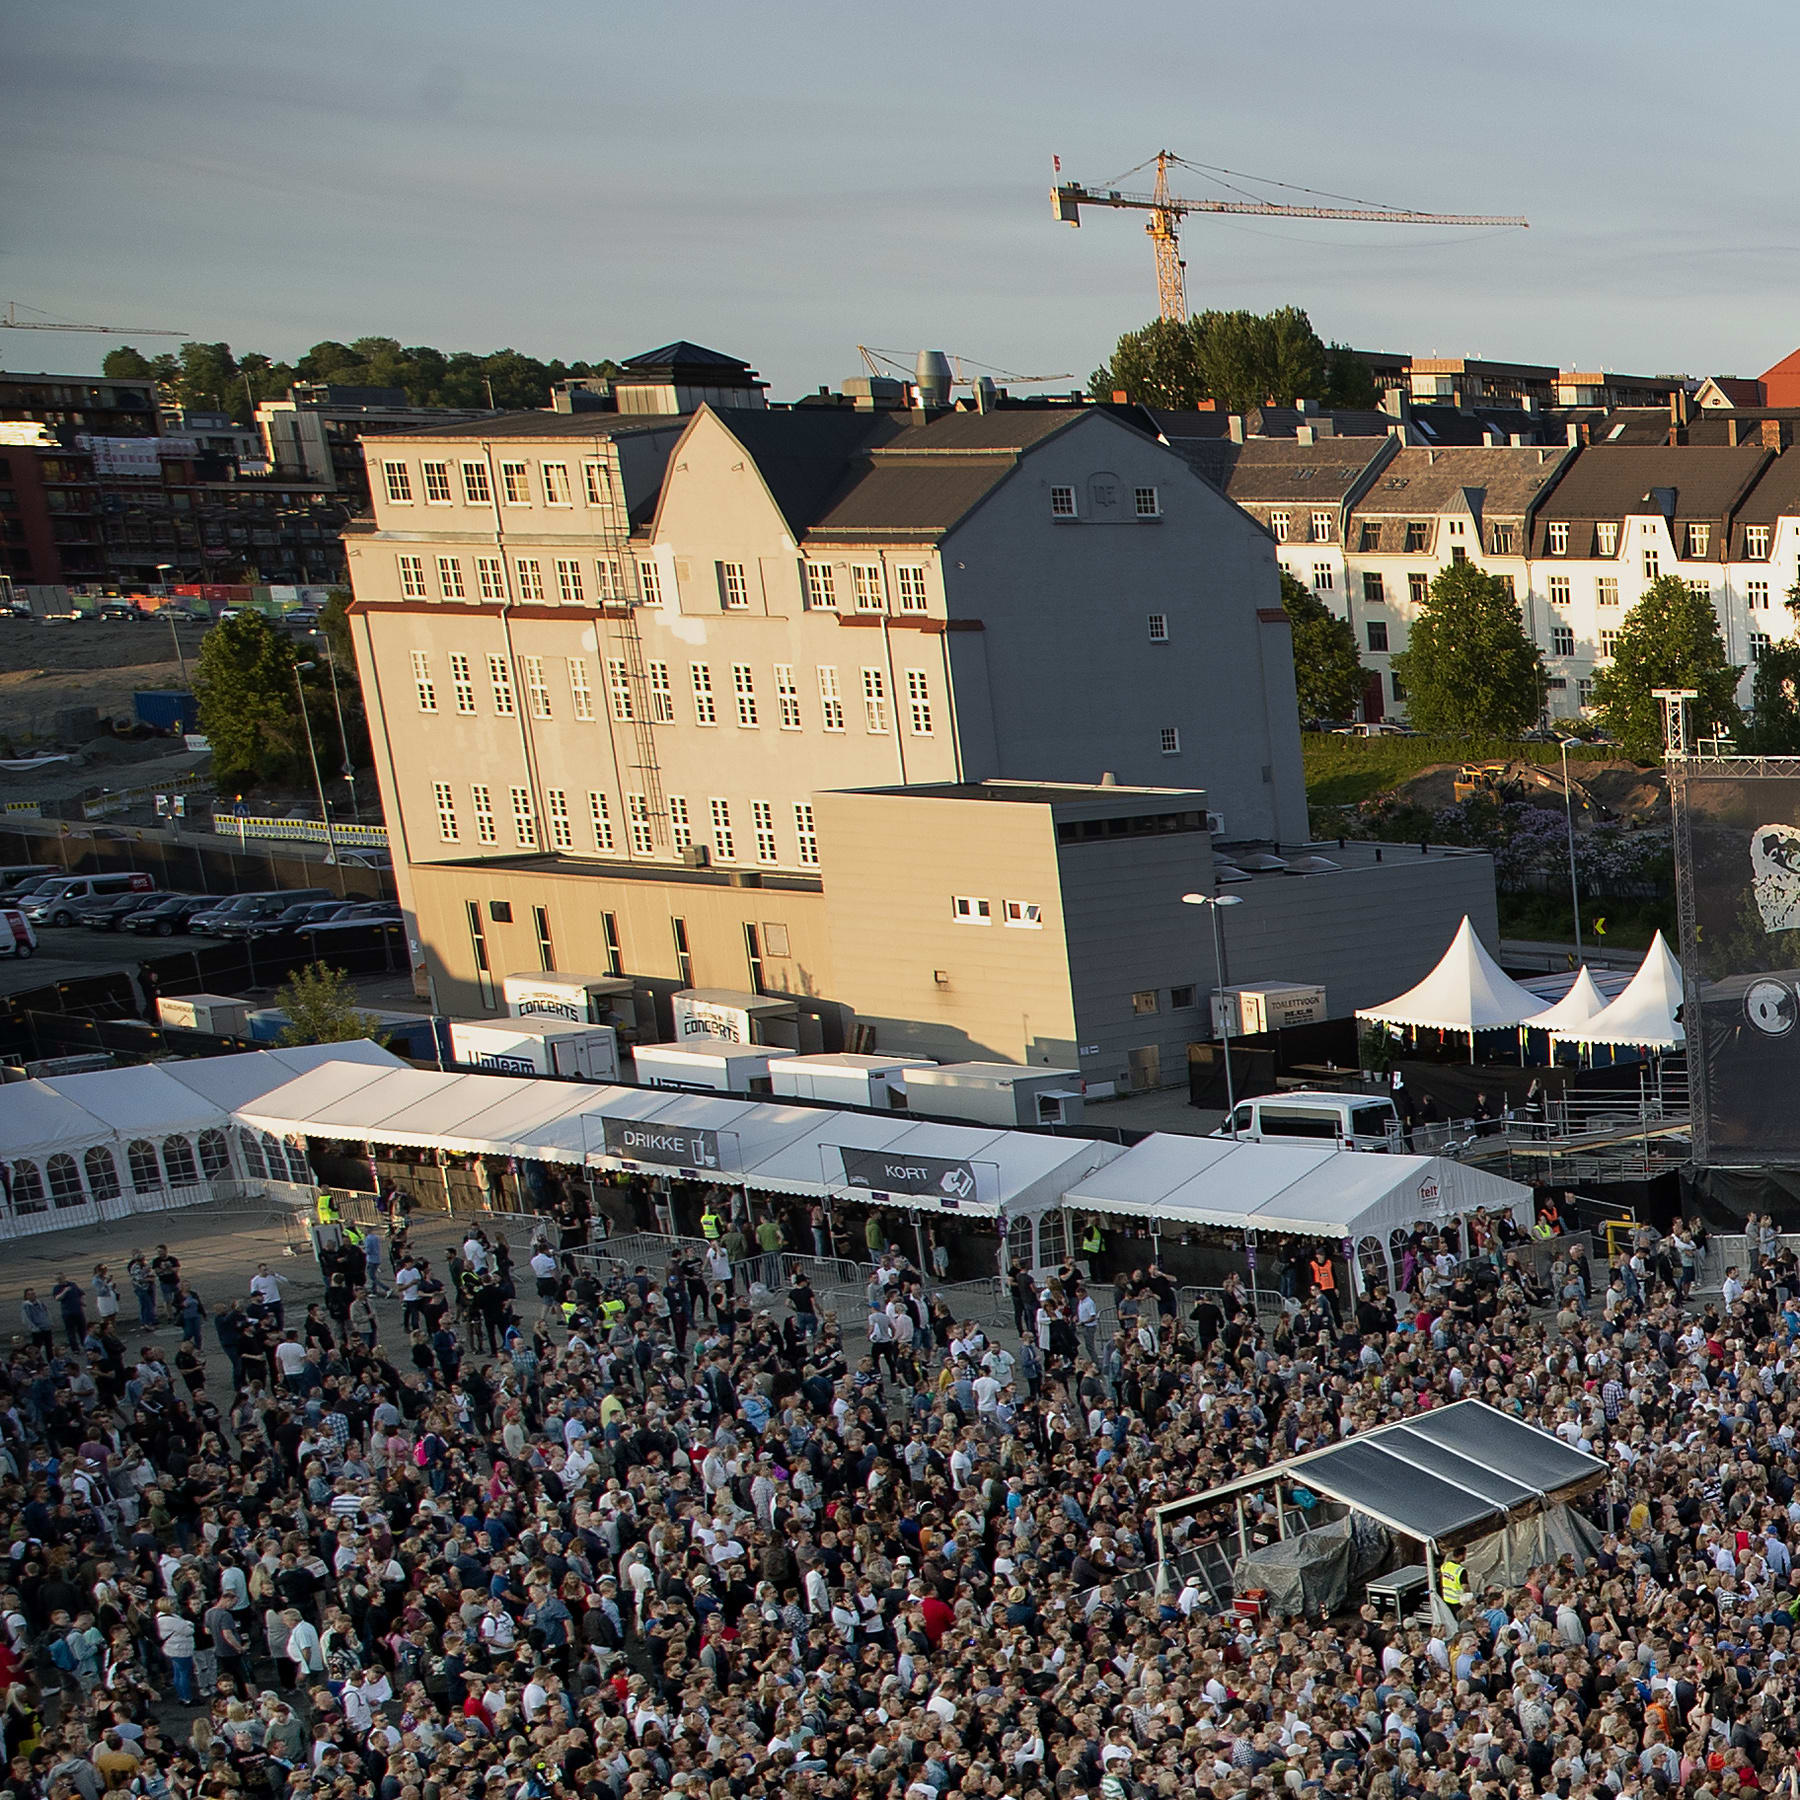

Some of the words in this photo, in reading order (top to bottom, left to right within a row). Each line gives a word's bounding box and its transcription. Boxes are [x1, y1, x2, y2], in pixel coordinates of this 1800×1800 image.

[685, 1018, 741, 1044] CONCERTS
[623, 1131, 685, 1153] DRIKKE
[884, 1164, 929, 1180] KORT
